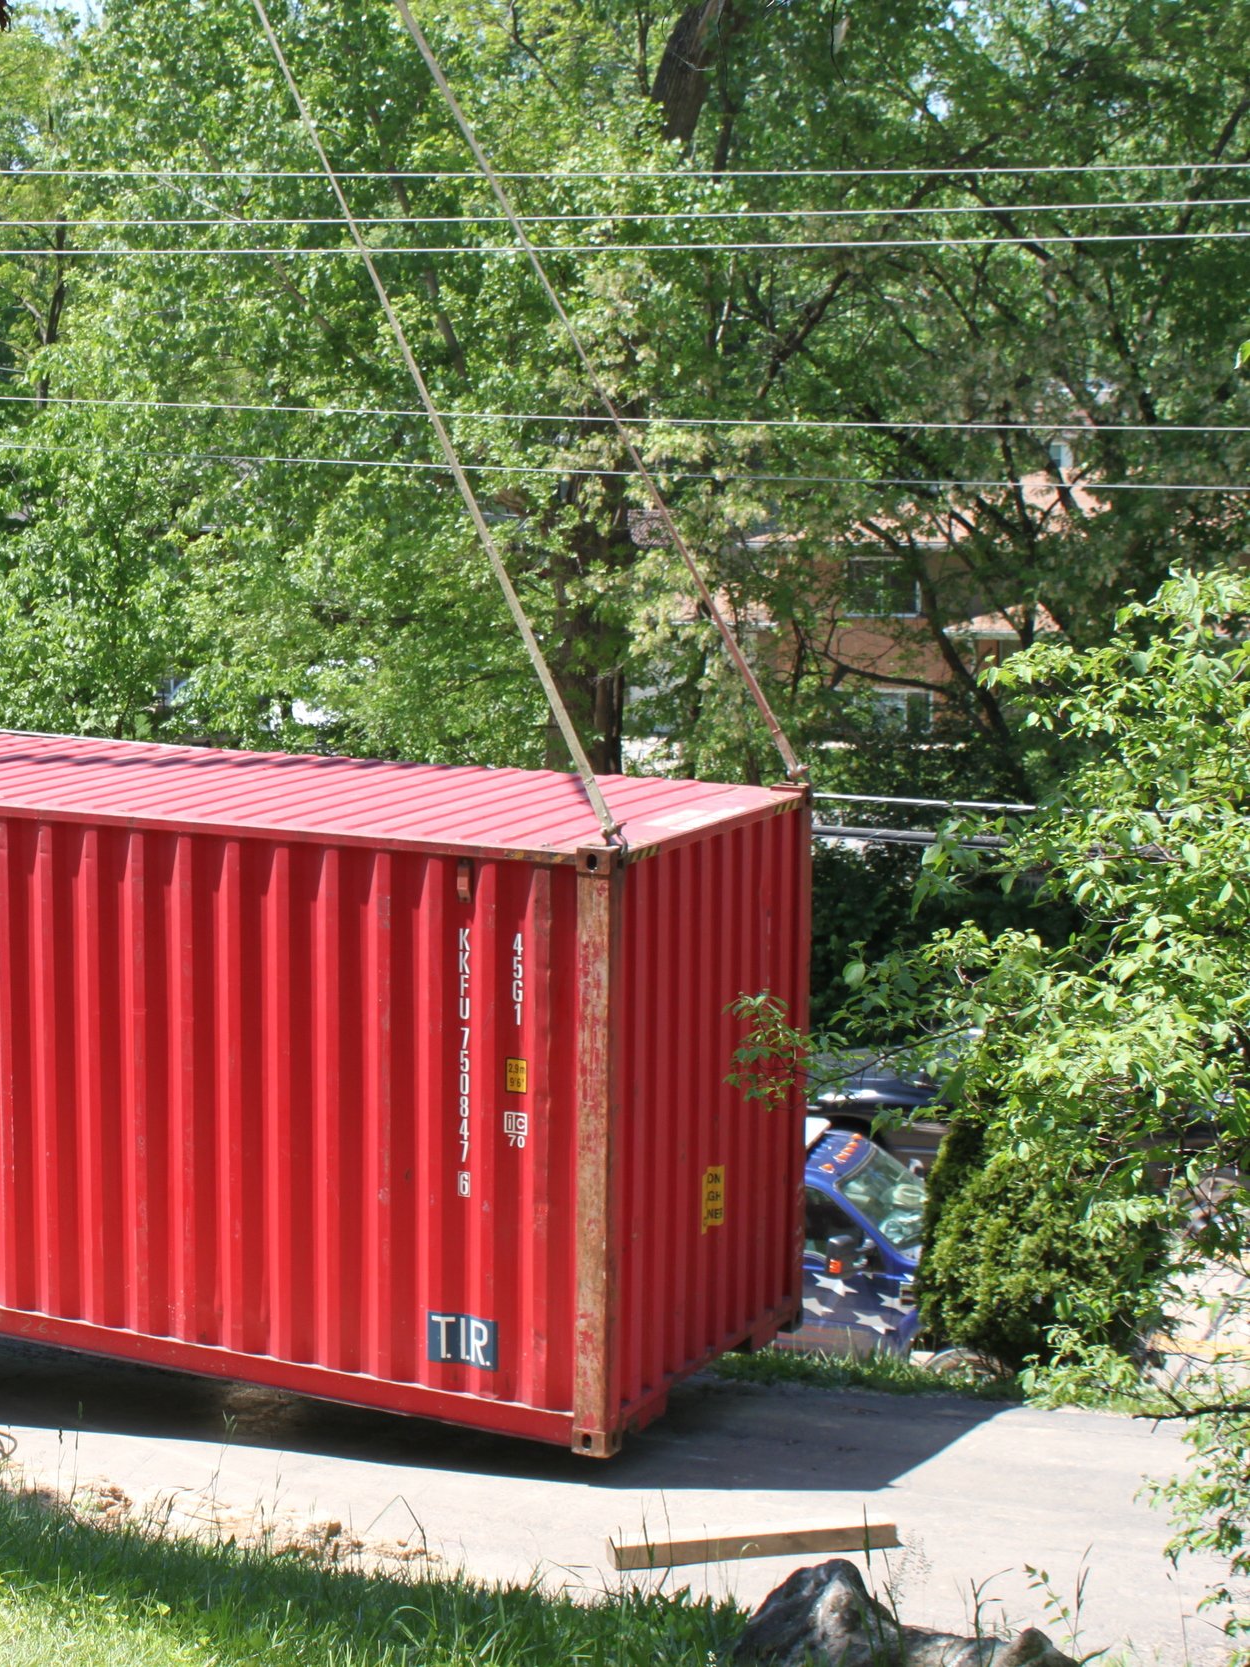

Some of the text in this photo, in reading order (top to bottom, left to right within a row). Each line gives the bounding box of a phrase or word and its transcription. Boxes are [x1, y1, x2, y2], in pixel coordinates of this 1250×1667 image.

[512, 932, 524, 1026] 45G1
[458, 927, 471, 1196] KKFU 750847 6
[507, 1134, 526, 1149] 70
